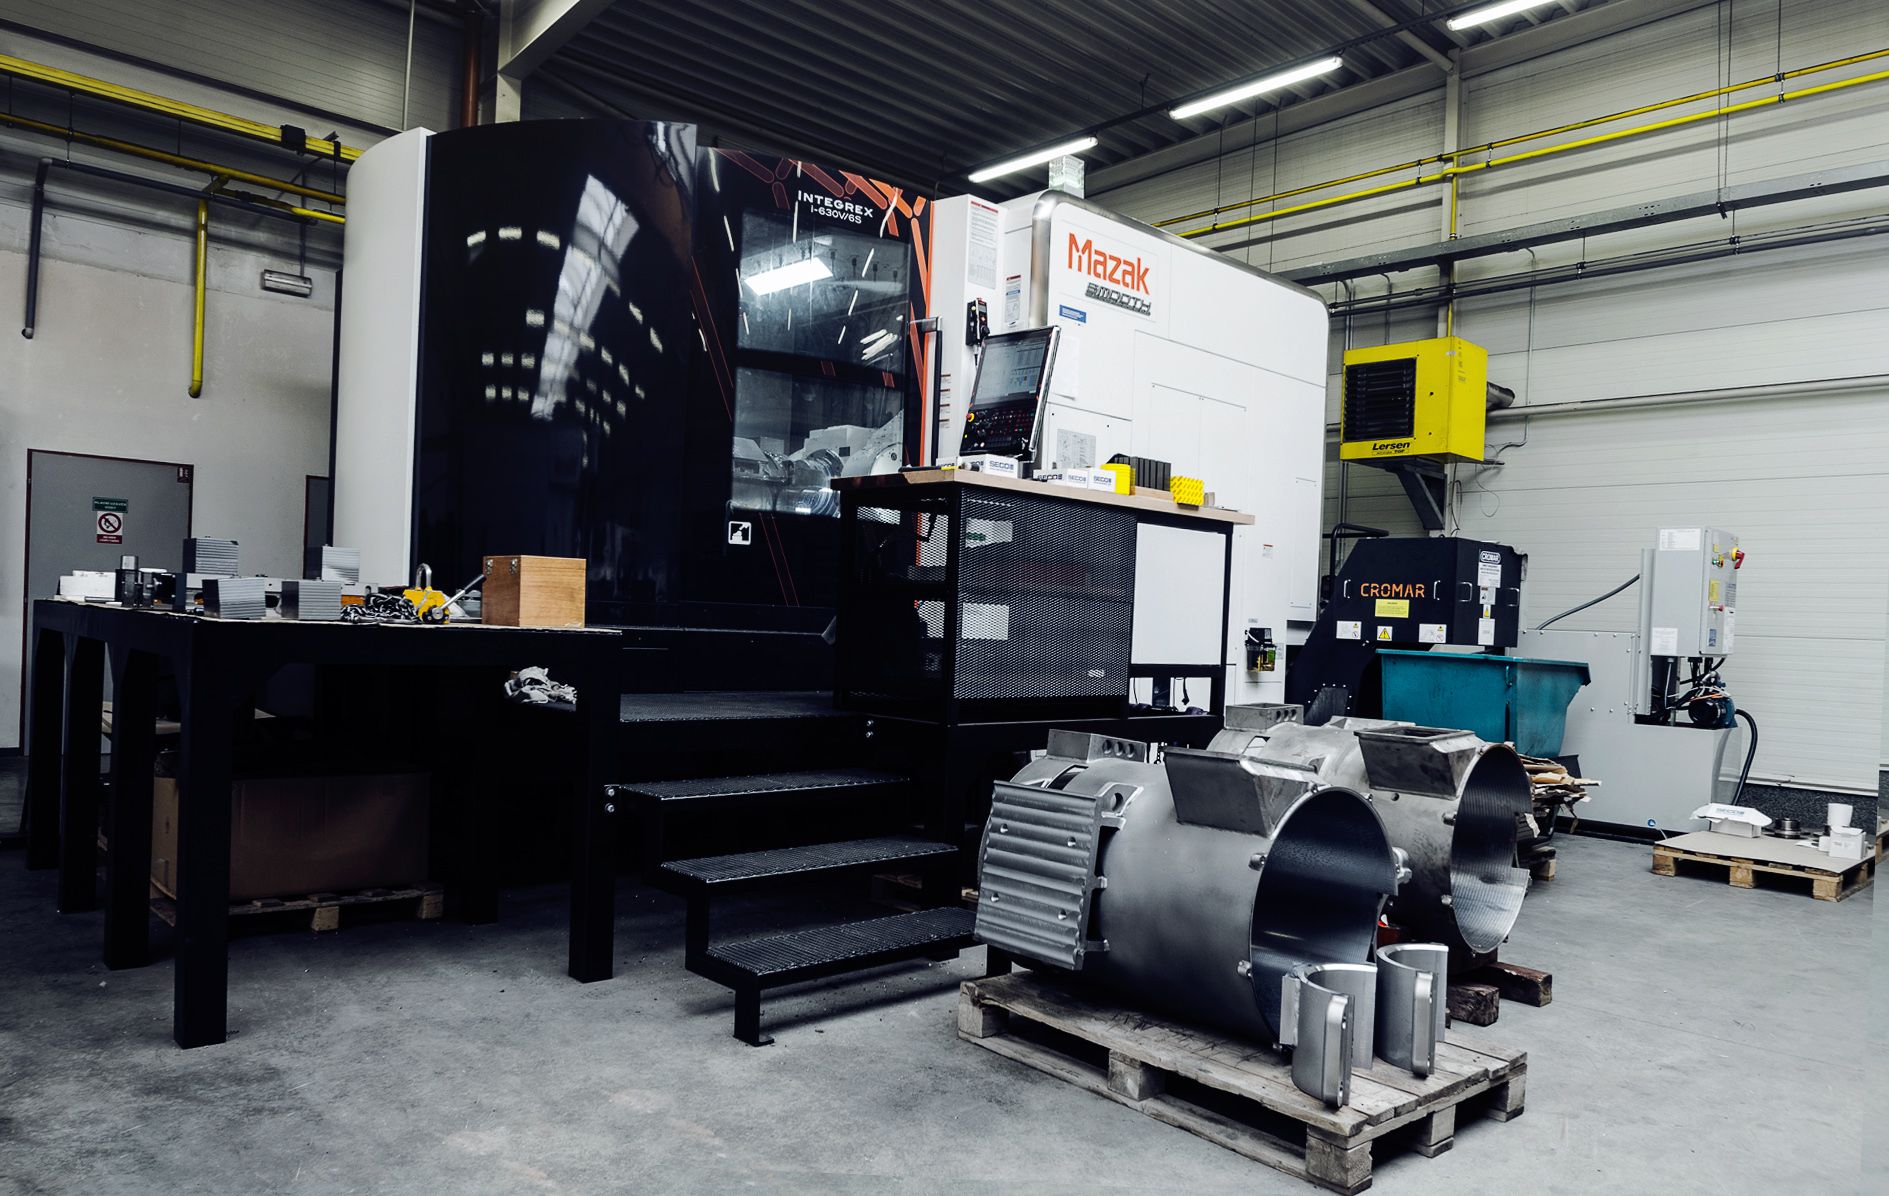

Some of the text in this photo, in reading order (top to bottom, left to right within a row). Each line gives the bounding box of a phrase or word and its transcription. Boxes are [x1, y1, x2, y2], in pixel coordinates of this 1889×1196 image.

[798, 190, 873, 218] INTEGREX
[1068, 232, 1150, 295] Mazak
[1372, 442, 1410, 451] Lersen
[989, 460, 1009, 470] SECO
[1361, 583, 1425, 598] CROMAR
